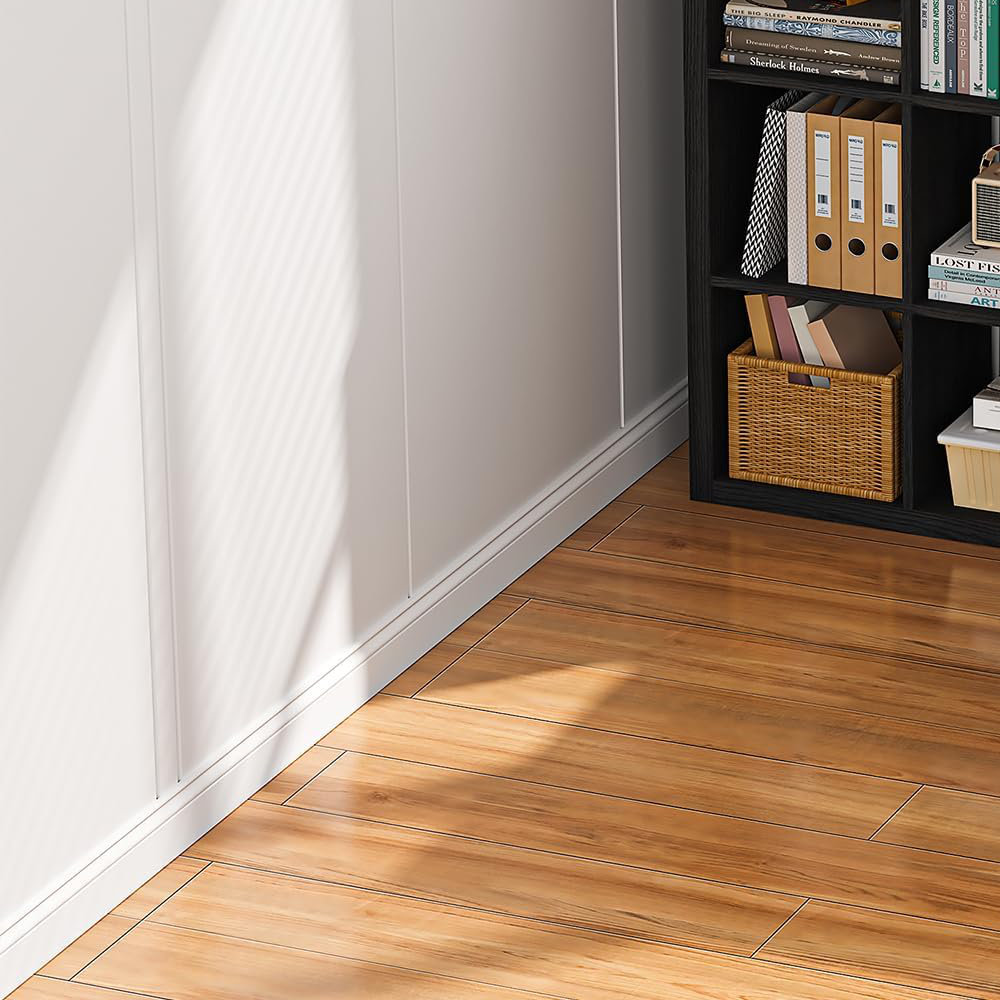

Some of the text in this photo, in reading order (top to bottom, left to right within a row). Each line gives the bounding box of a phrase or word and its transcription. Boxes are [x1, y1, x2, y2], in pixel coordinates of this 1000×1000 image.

[796, 15, 837, 24] RAYMOND
[840, 19, 881, 27] CHANDLER
[946, 4, 954, 43] BORDEAUX
[745, 39, 780, 49] Dreaming
[789, 45, 817, 53] Sweden
[932, 18, 940, 65] REFERENCED
[749, 56, 820, 75] Sherlock Holmes
[935, 256, 975, 269] LOST
[970, 296, 998, 307] ART
